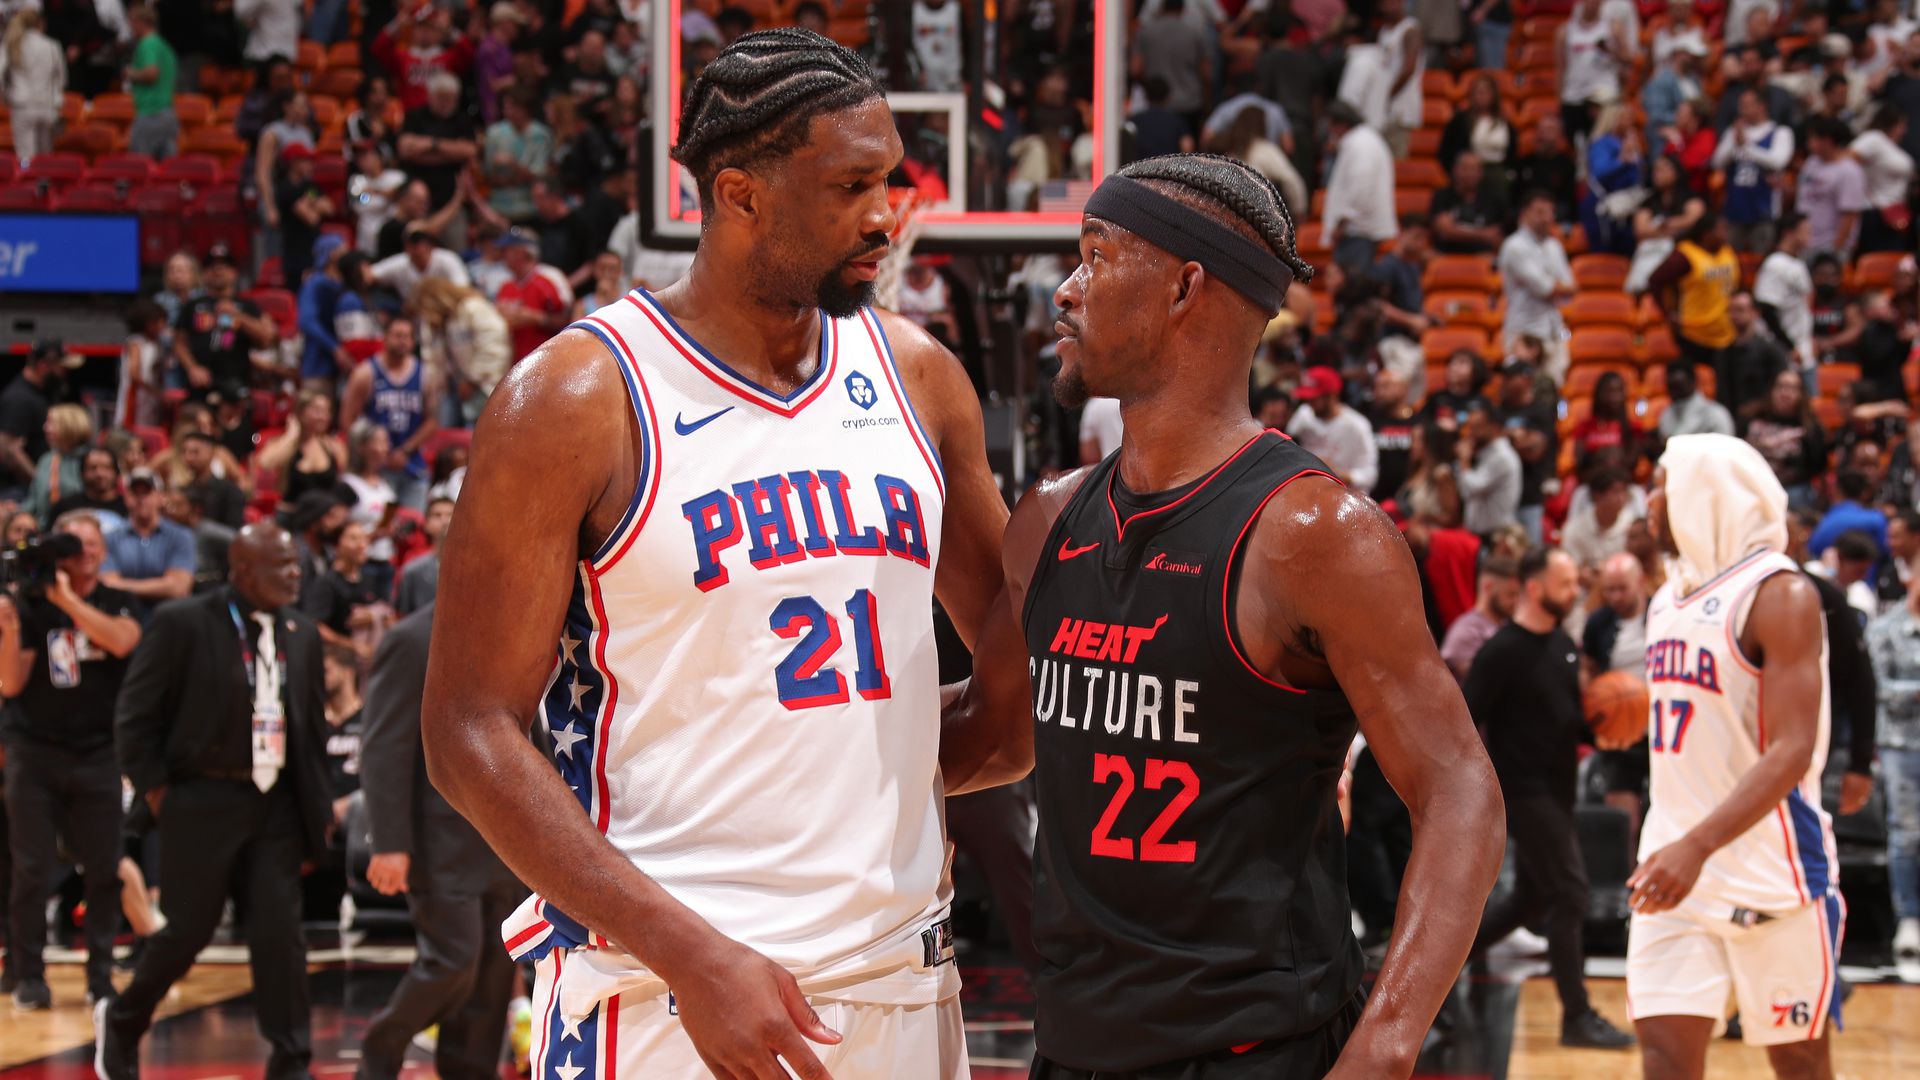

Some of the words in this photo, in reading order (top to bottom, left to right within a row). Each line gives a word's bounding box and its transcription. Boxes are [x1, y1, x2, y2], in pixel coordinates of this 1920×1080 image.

[842, 417, 899, 429] crypto.com
[681, 469, 930, 592] PHILA
[1159, 560, 1201, 575] Carnival
[769, 588, 891, 711] 21
[1050, 613, 1168, 663] HEAT
[1651, 700, 1694, 753] 17
[1090, 753, 1200, 863] 22
[1771, 1001, 1809, 1028] 76
